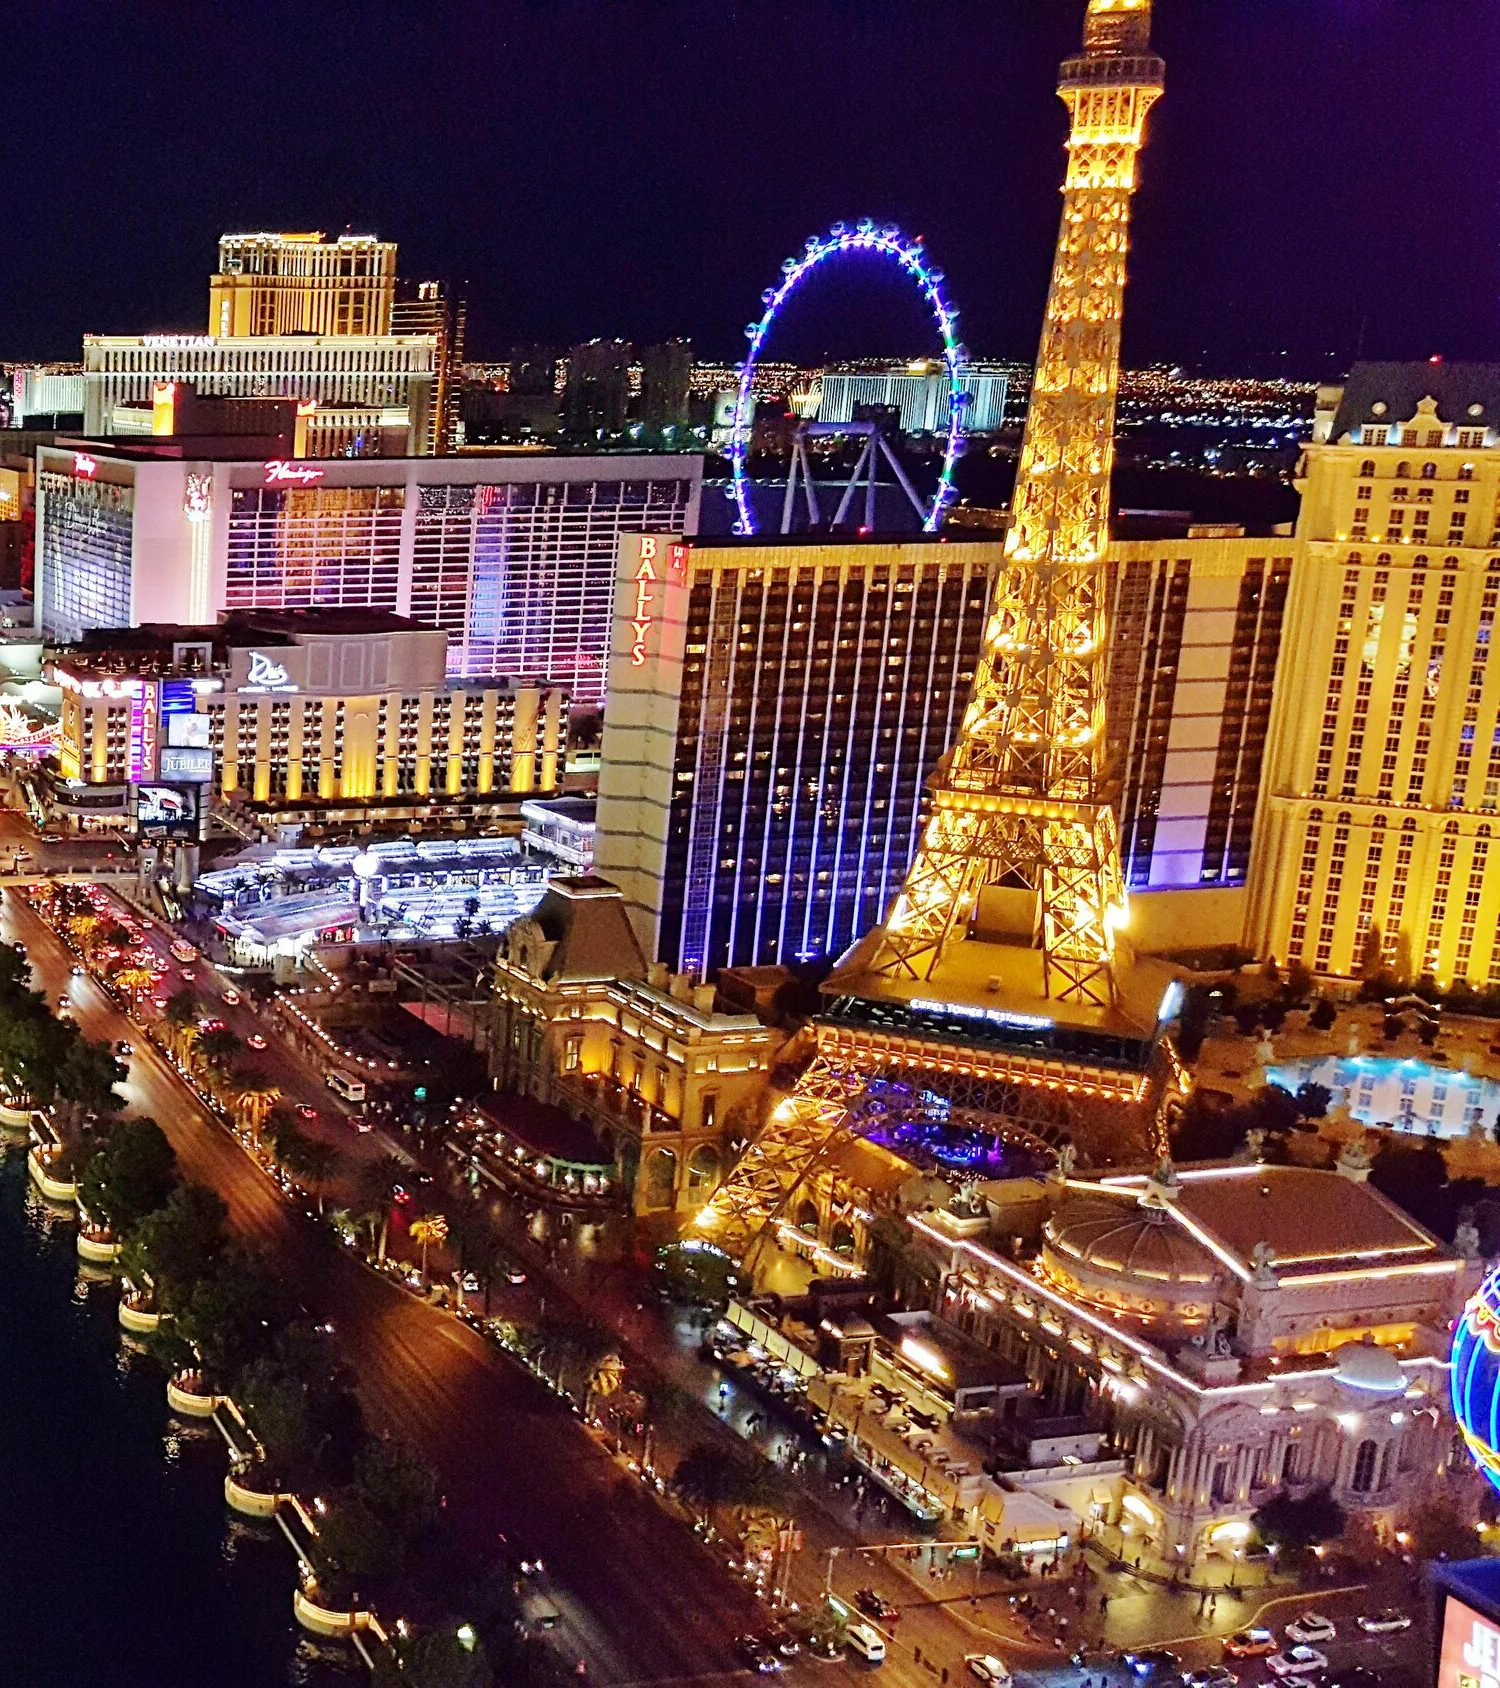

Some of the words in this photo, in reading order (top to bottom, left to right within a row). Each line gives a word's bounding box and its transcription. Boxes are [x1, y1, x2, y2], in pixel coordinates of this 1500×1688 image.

[144, 335, 217, 348] VENETIAN
[910, 999, 945, 1013] EIFFEL
[946, 1003, 985, 1018] TOWER
[986, 1009, 1054, 1028] RESTAURANT
